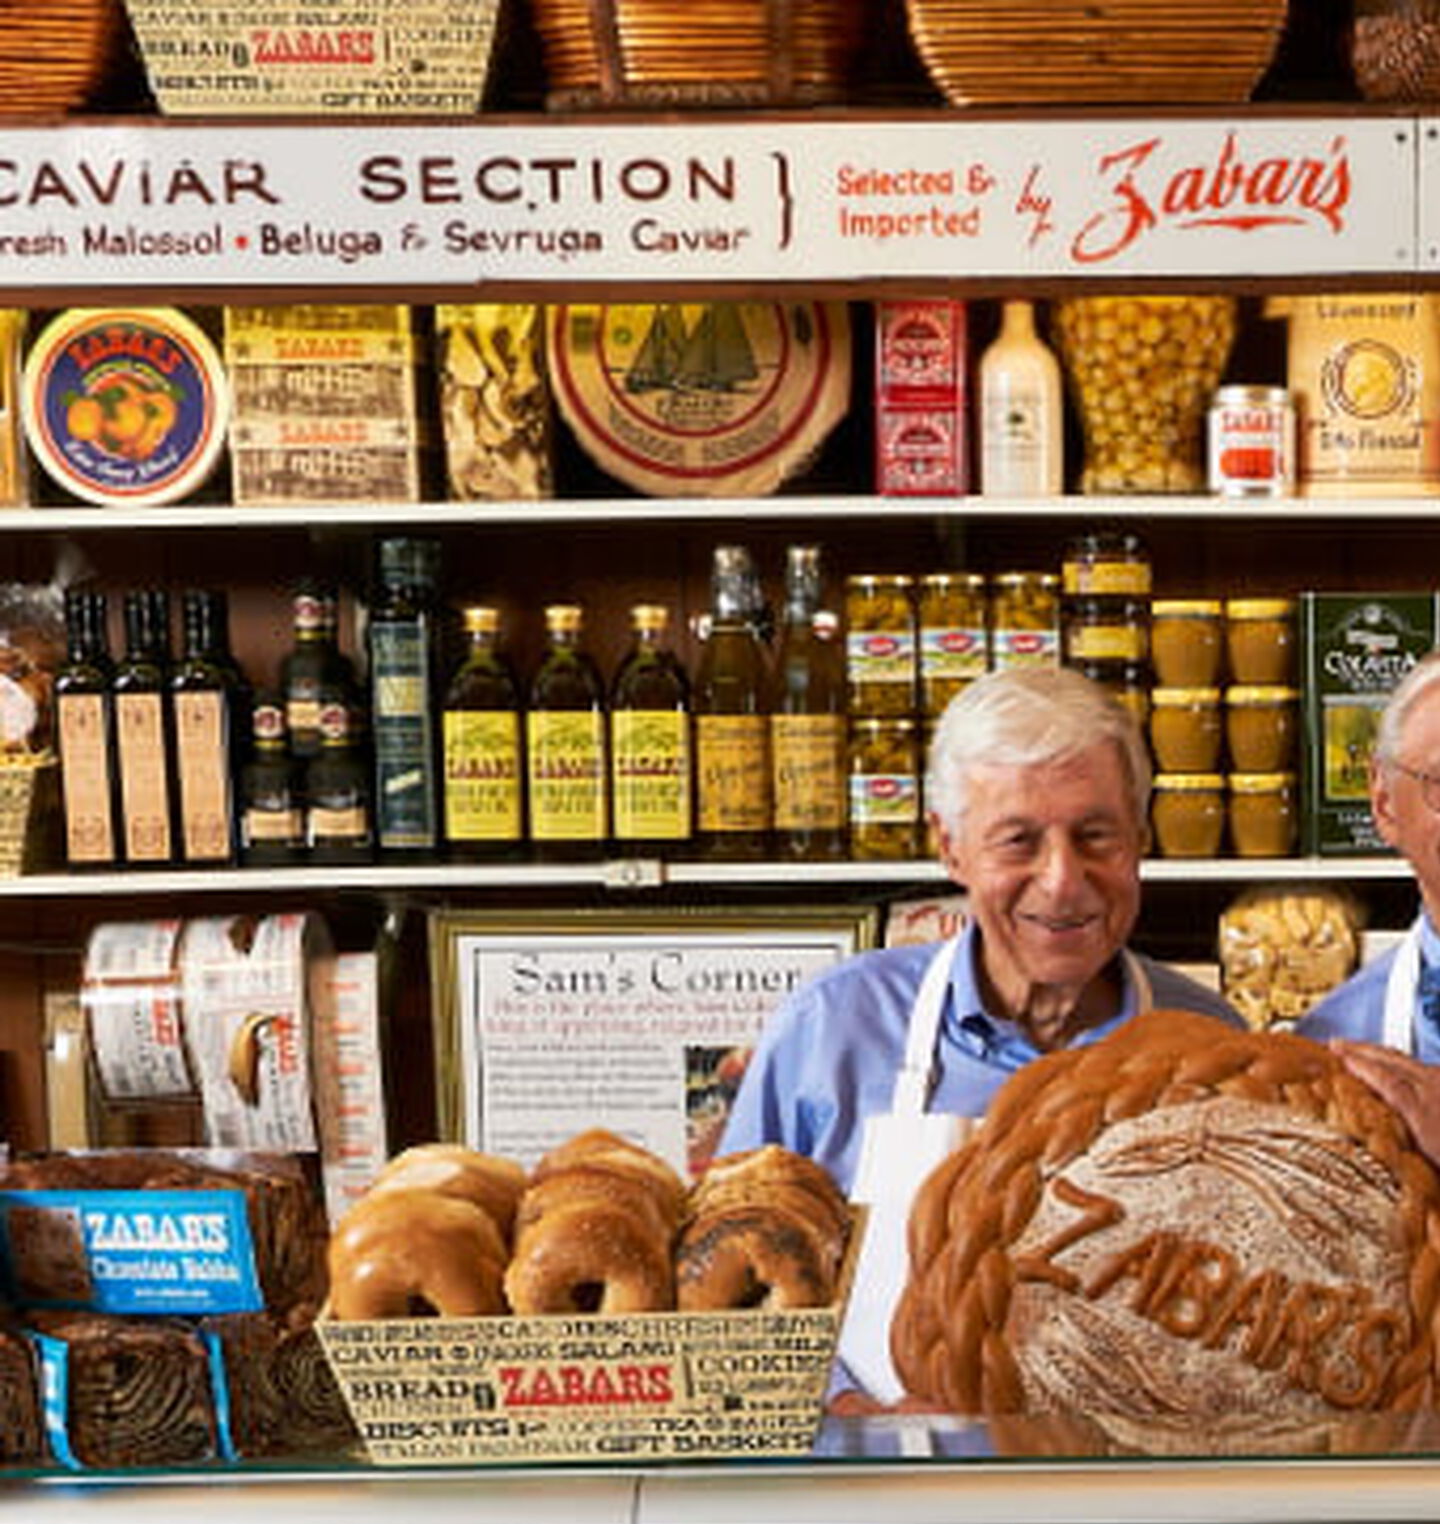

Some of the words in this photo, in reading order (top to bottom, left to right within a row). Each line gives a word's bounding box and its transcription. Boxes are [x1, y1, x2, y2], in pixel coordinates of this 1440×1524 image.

[358, 155, 737, 205] SECTION
[836, 165, 954, 197] Selected
[0, 227, 67, 256] resh
[82, 222, 223, 257] Malossol
[259, 221, 383, 264] Beluga
[443, 219, 604, 263] Sevruga
[631, 218, 751, 252] Caviar
[839, 208, 982, 239] Imported
[512, 952, 634, 996] Sam's
[650, 951, 801, 995] Corner
[86, 1213, 230, 1251] ZABARS
[351, 1379, 471, 1402] BREAD
[499, 1365, 674, 1406] ZABARS
